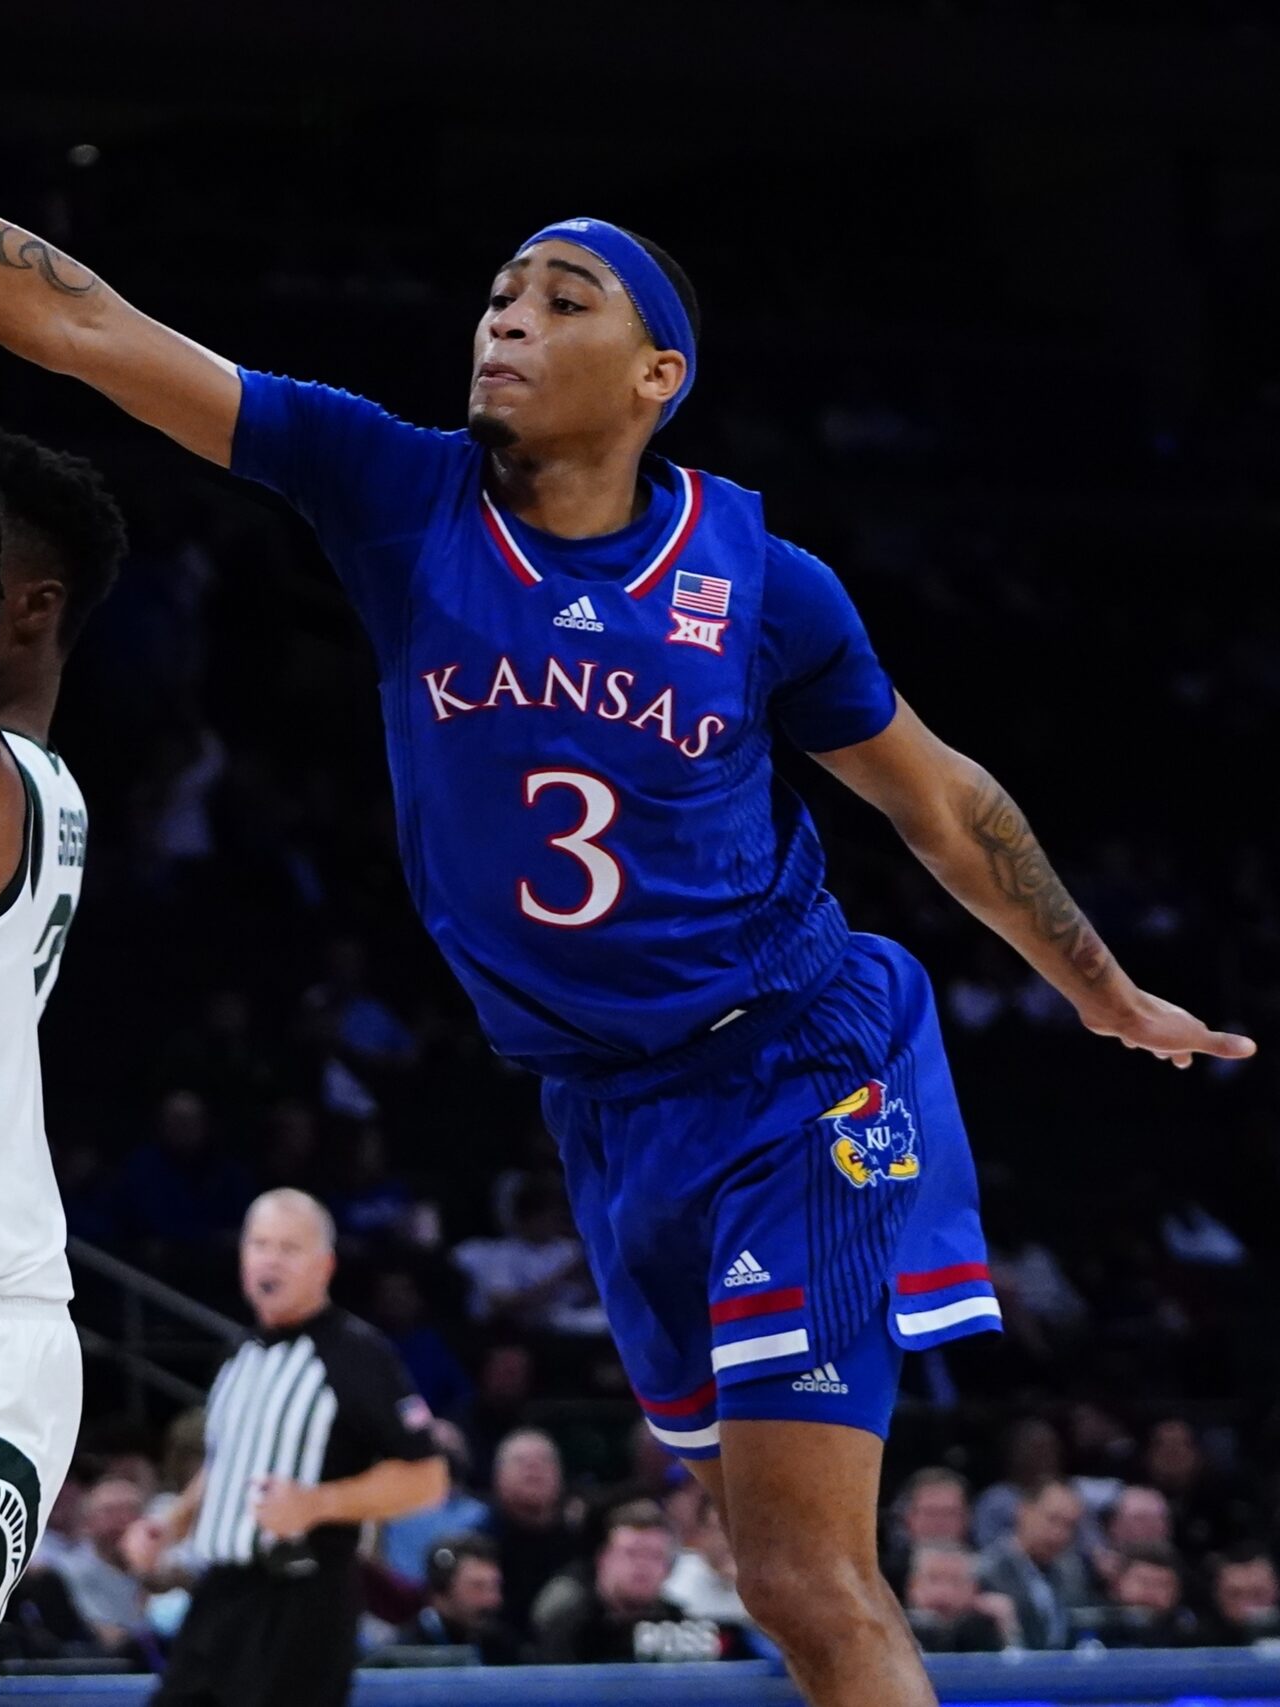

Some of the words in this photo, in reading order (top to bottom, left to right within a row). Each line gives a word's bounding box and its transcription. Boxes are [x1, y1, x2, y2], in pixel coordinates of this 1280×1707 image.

[553, 614, 604, 633] adidas
[422, 656, 725, 759] KANSAS
[517, 766, 623, 928] 3
[866, 1126, 891, 1150] KU
[723, 1270, 771, 1288] adidas
[791, 1381, 849, 1395] adidas
